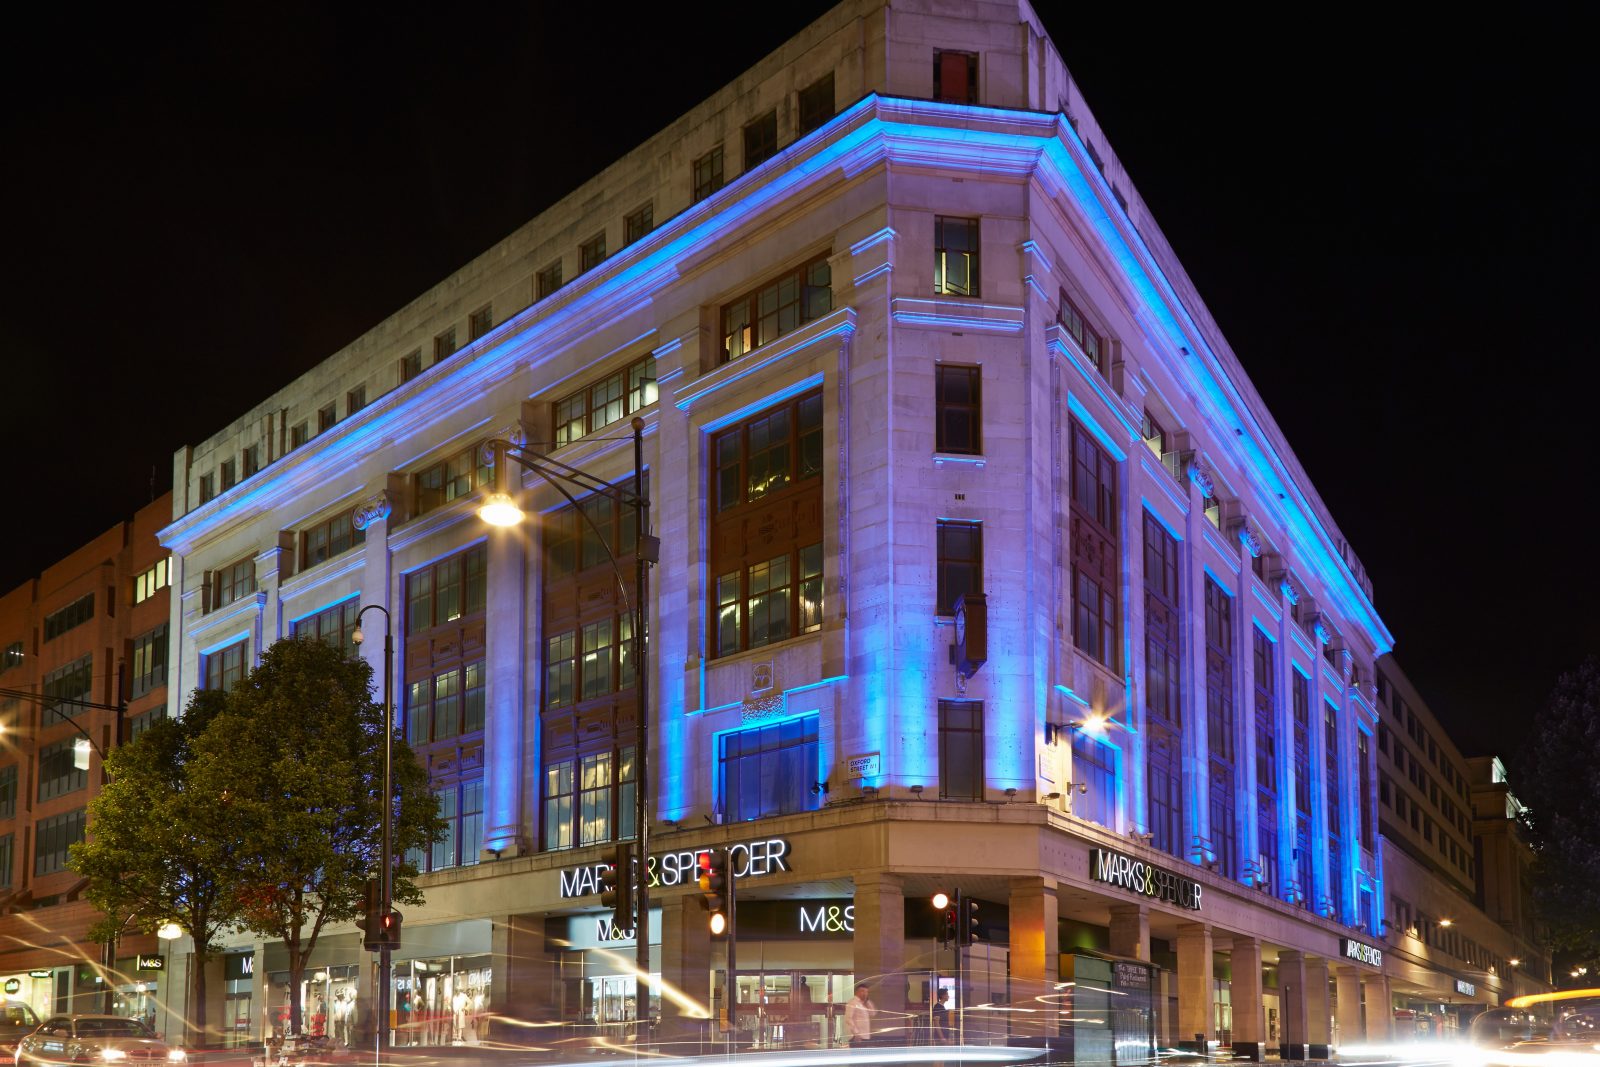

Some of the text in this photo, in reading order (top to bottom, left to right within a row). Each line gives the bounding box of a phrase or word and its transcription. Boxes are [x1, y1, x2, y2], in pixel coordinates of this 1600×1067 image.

[850, 758, 871, 766] OXFORD
[850, 764, 868, 772] STREET
[140, 958, 162, 968] M&S
